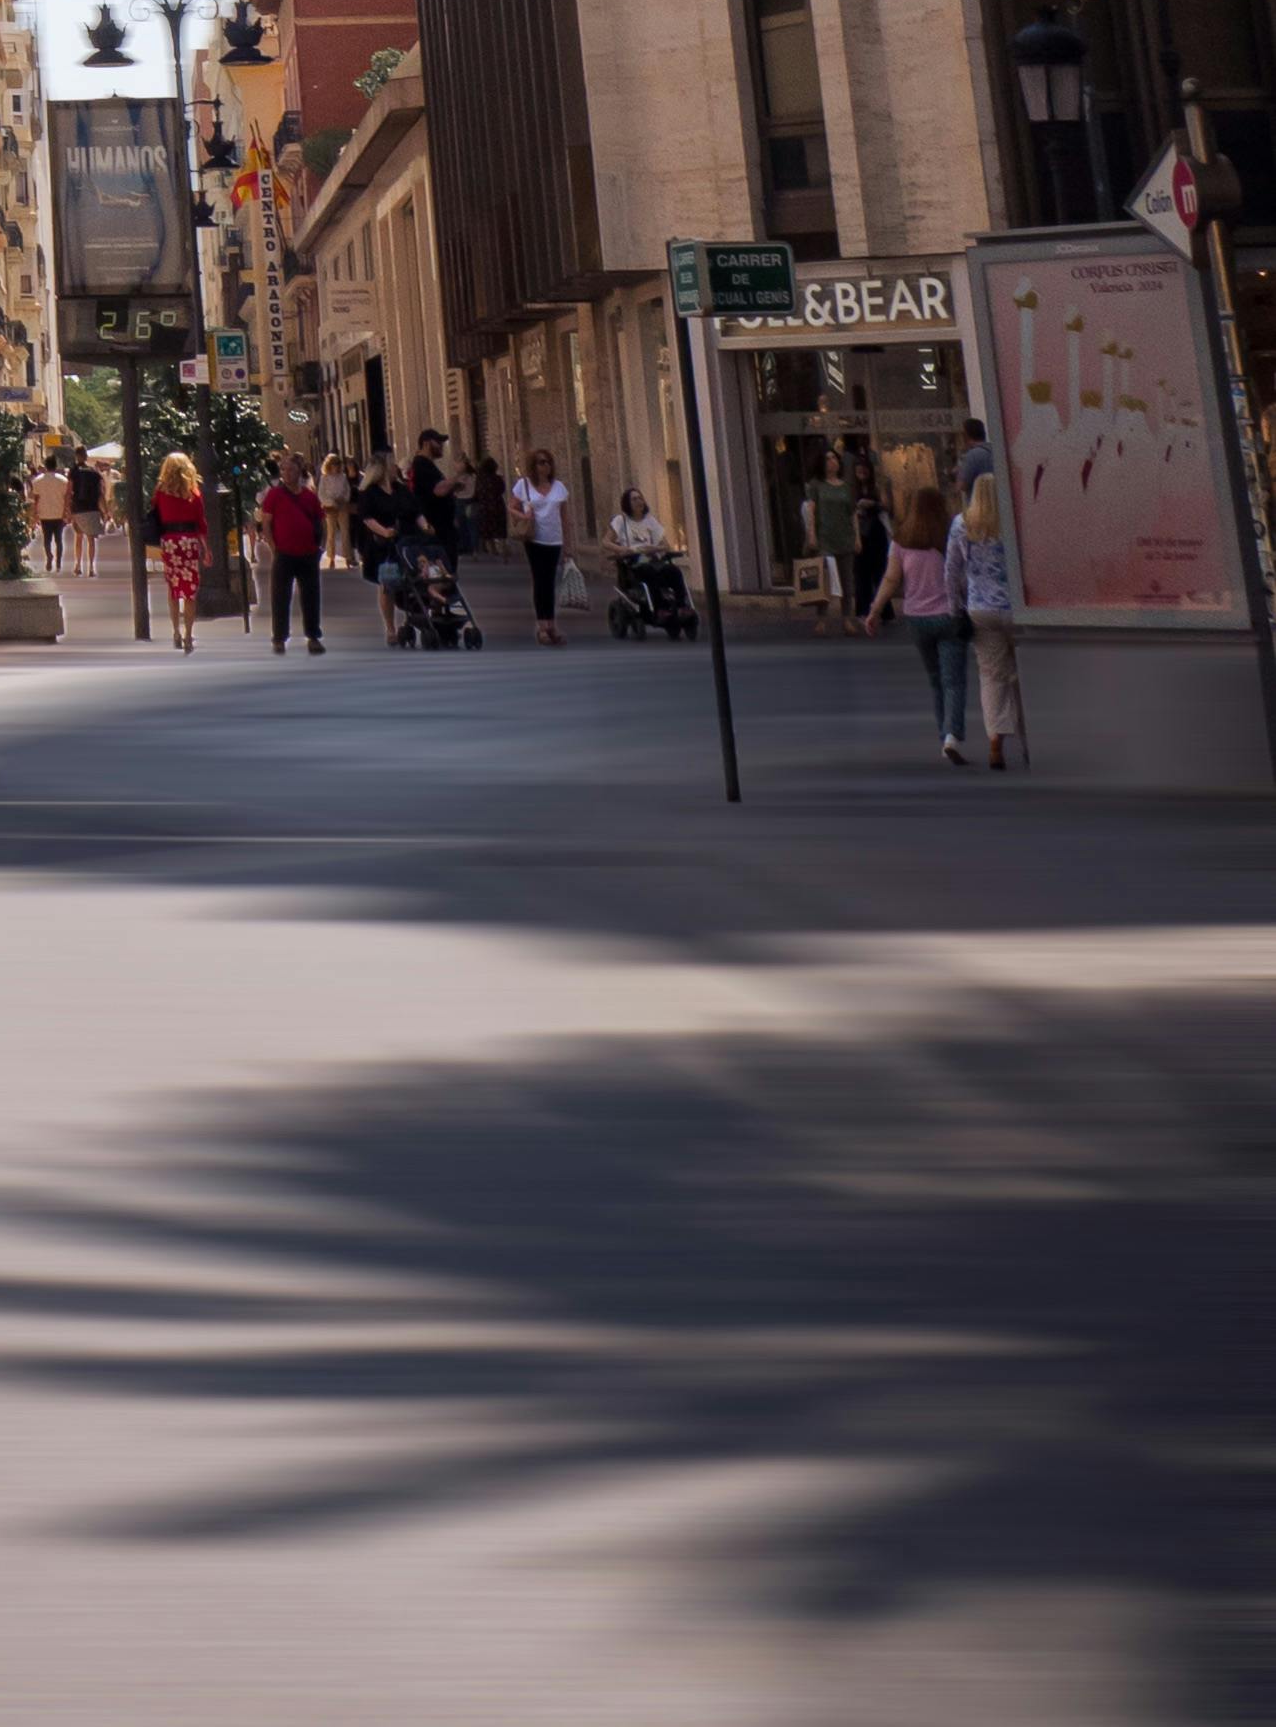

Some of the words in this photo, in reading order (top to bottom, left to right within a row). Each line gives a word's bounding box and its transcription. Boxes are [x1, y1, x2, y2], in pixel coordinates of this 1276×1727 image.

[66, 146, 168, 174] HUMANOS
[260, 173, 277, 252] CENTRO
[1145, 189, 1173, 215] Colón
[716, 253, 783, 268] CARRER
[731, 273, 751, 285] DE
[1070, 263, 1124, 280] CORPUS
[711, 291, 748, 305] SCUAL
[266, 261, 285, 371] ARAGONES
